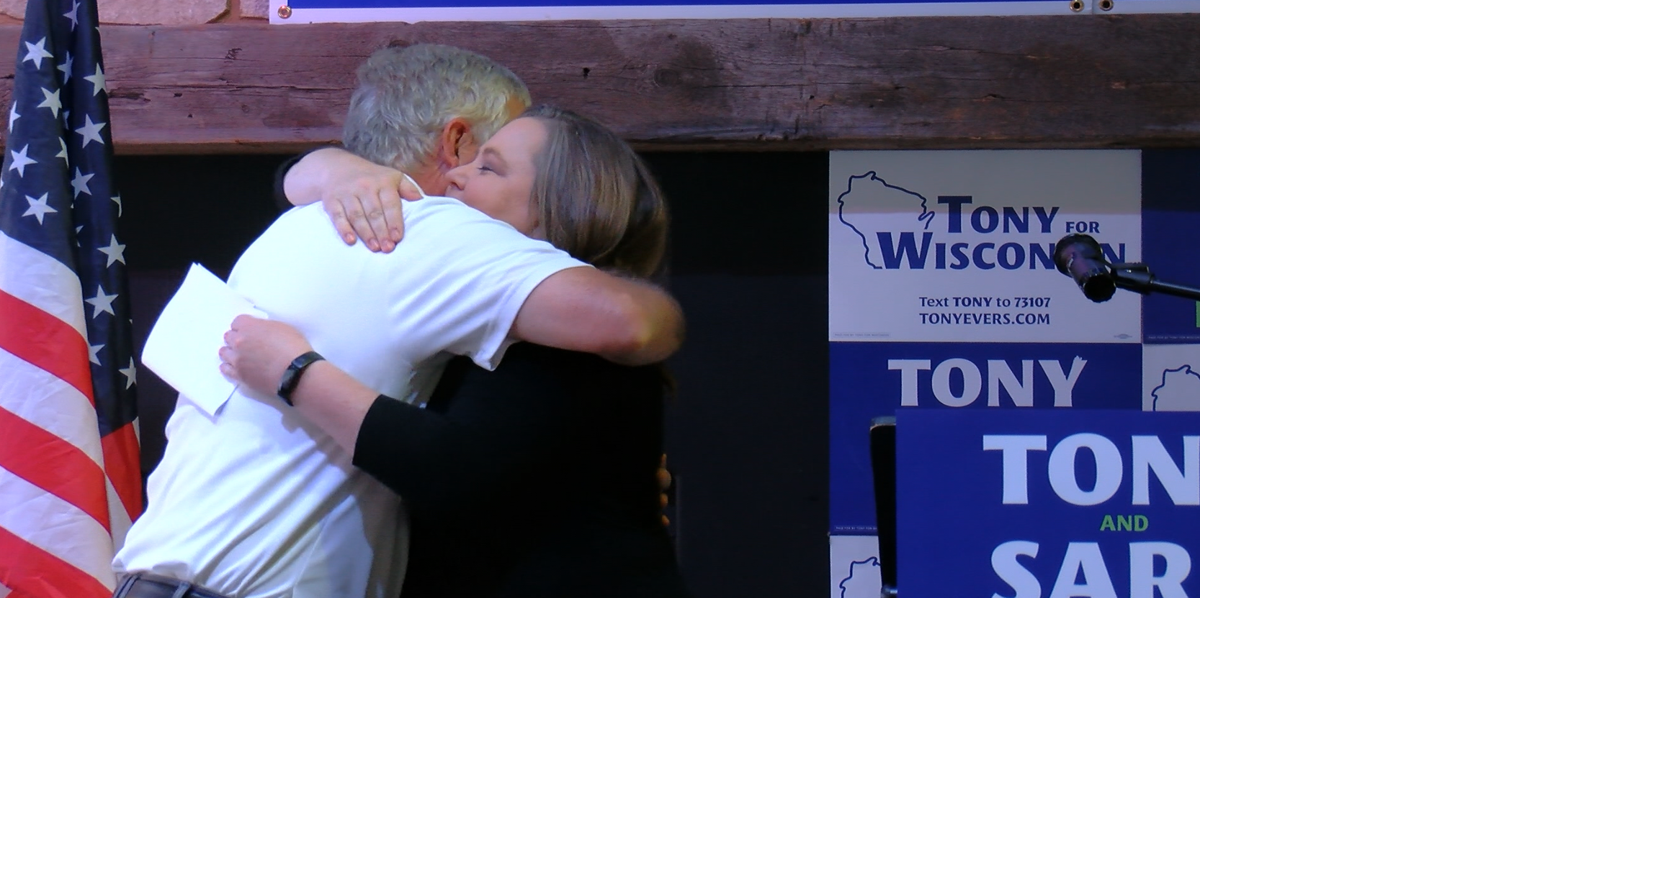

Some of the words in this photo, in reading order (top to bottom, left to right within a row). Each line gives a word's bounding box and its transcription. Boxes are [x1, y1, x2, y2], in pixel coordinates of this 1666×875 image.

[938, 195, 1060, 234] TONY
[1065, 221, 1100, 234] FOR
[876, 231, 1126, 270] WISCONN
[919, 296, 949, 307] Text
[953, 296, 993, 308] TONY
[996, 297, 1011, 308] to
[1014, 297, 1051, 308] 73107
[919, 312, 1050, 325] TONYEVERS.COM
[887, 355, 1088, 407] TONY
[1100, 514, 1149, 532] AND
[991, 540, 1192, 598] SAR
